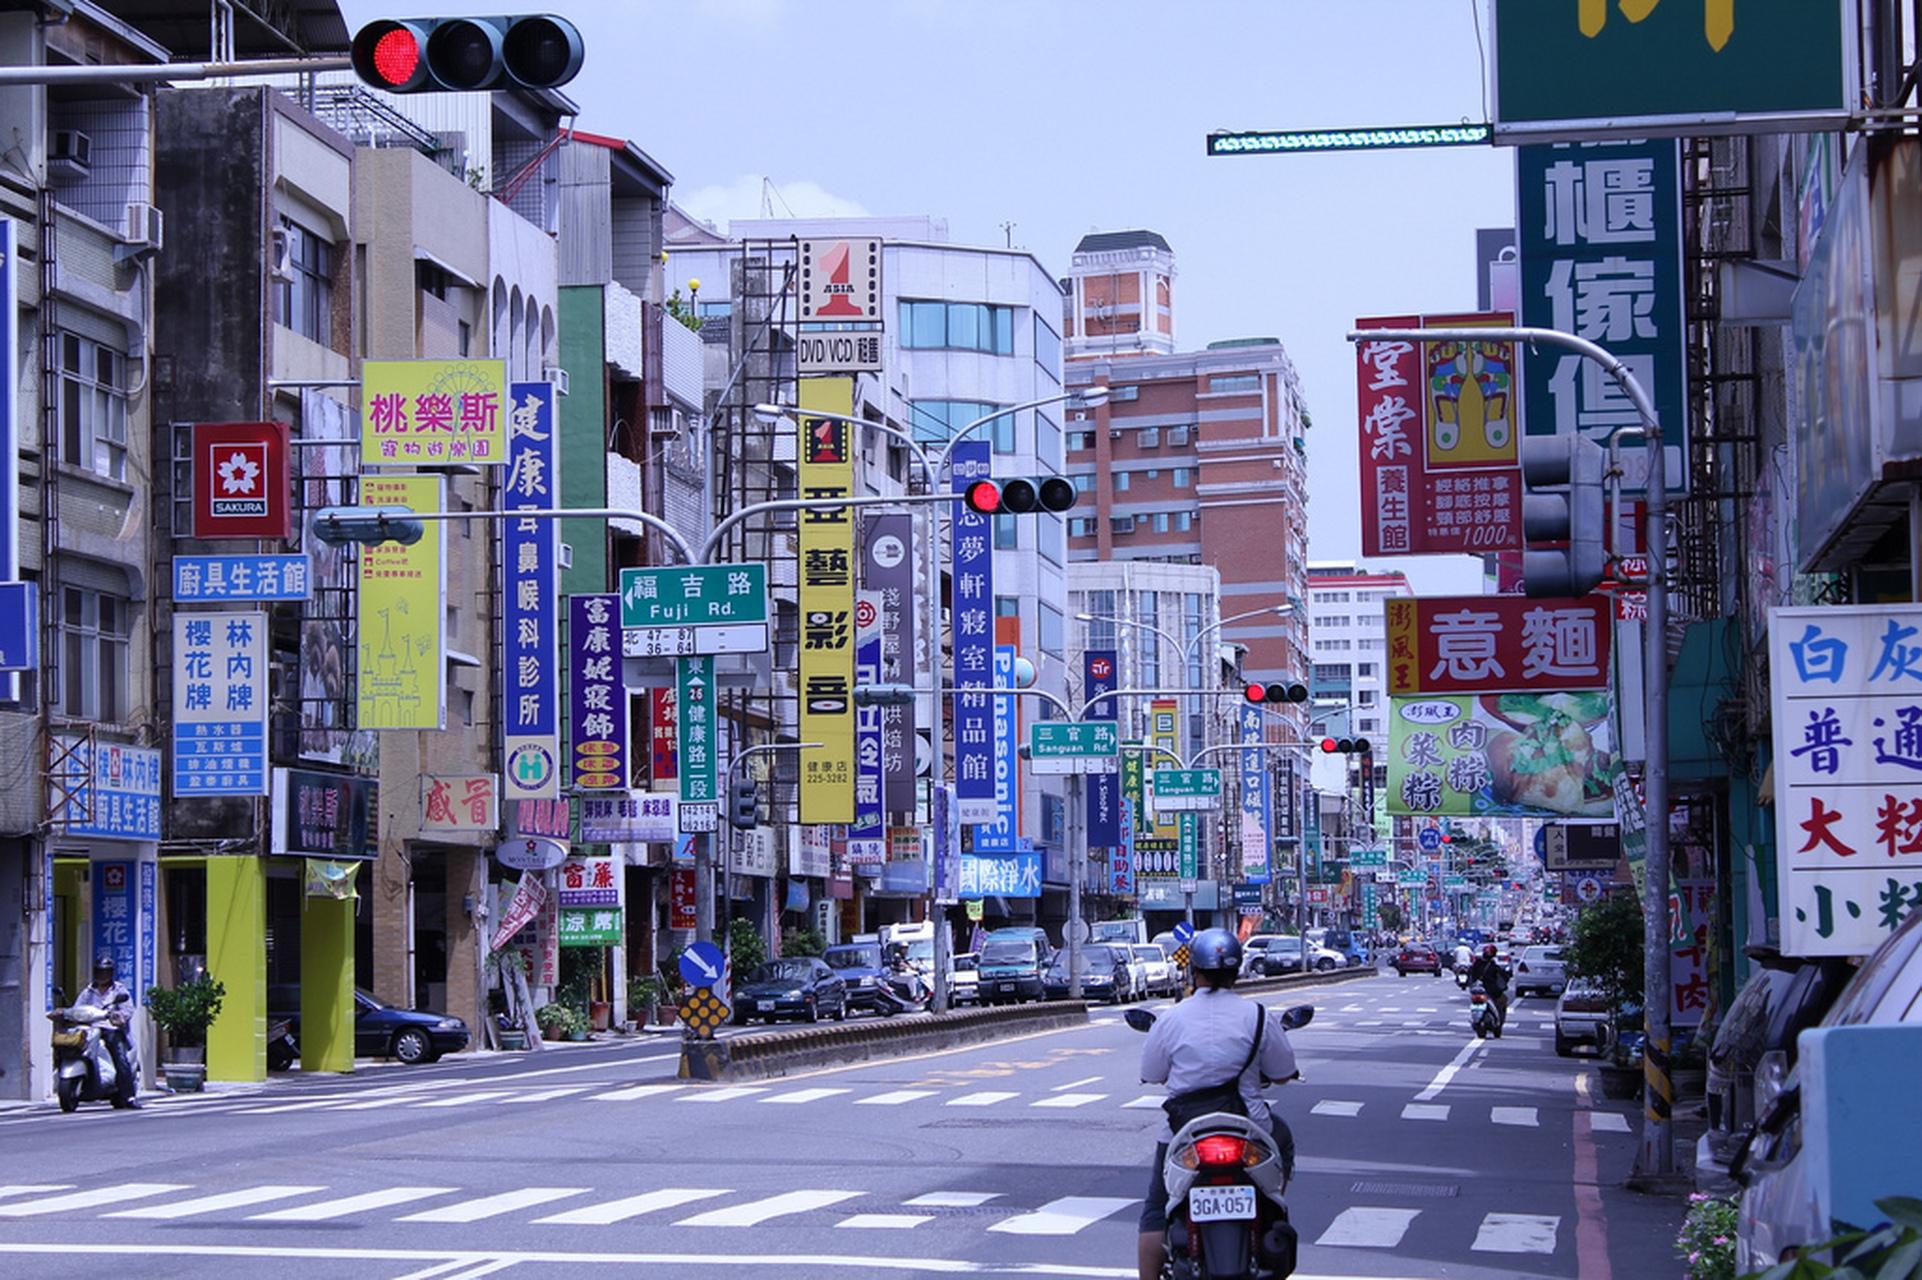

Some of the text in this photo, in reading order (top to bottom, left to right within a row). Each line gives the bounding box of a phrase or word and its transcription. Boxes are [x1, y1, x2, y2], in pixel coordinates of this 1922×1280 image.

[823, 284, 855, 294] ASIA
[1544, 140, 1658, 440] 櫃傢俱
[369, 392, 499, 434] 桃樂斯
[215, 502, 264, 513] SAKURA
[1380, 469, 1408, 550] 養生館
[177, 561, 307, 597] 廚具生活館
[507, 393, 549, 726] 健康耳鼻喉科診所
[633, 571, 752, 600] 福吉路
[650, 601, 736, 621] Fuji Rd.
[804, 487, 849, 715] 亞藝影音
[184, 619, 212, 711] 櫻花牌
[226, 619, 252, 711] 林內牌
[624, 633, 639, 646] 北
[1429, 606, 1600, 680] 意麵
[880, 586, 903, 773] 淺野屋精烘焙坊
[687, 704, 708, 798] 健康路二段
[995, 653, 1013, 835] Panasonic
[1038, 743, 1084, 754] Sanguan
[1448, 721, 1491, 793] 肉粽
[1790, 706, 1922, 775] 普通
[806, 773, 848, 784] 225-3282
[563, 862, 614, 888] 窗簾
[102, 896, 129, 944] 櫻花
